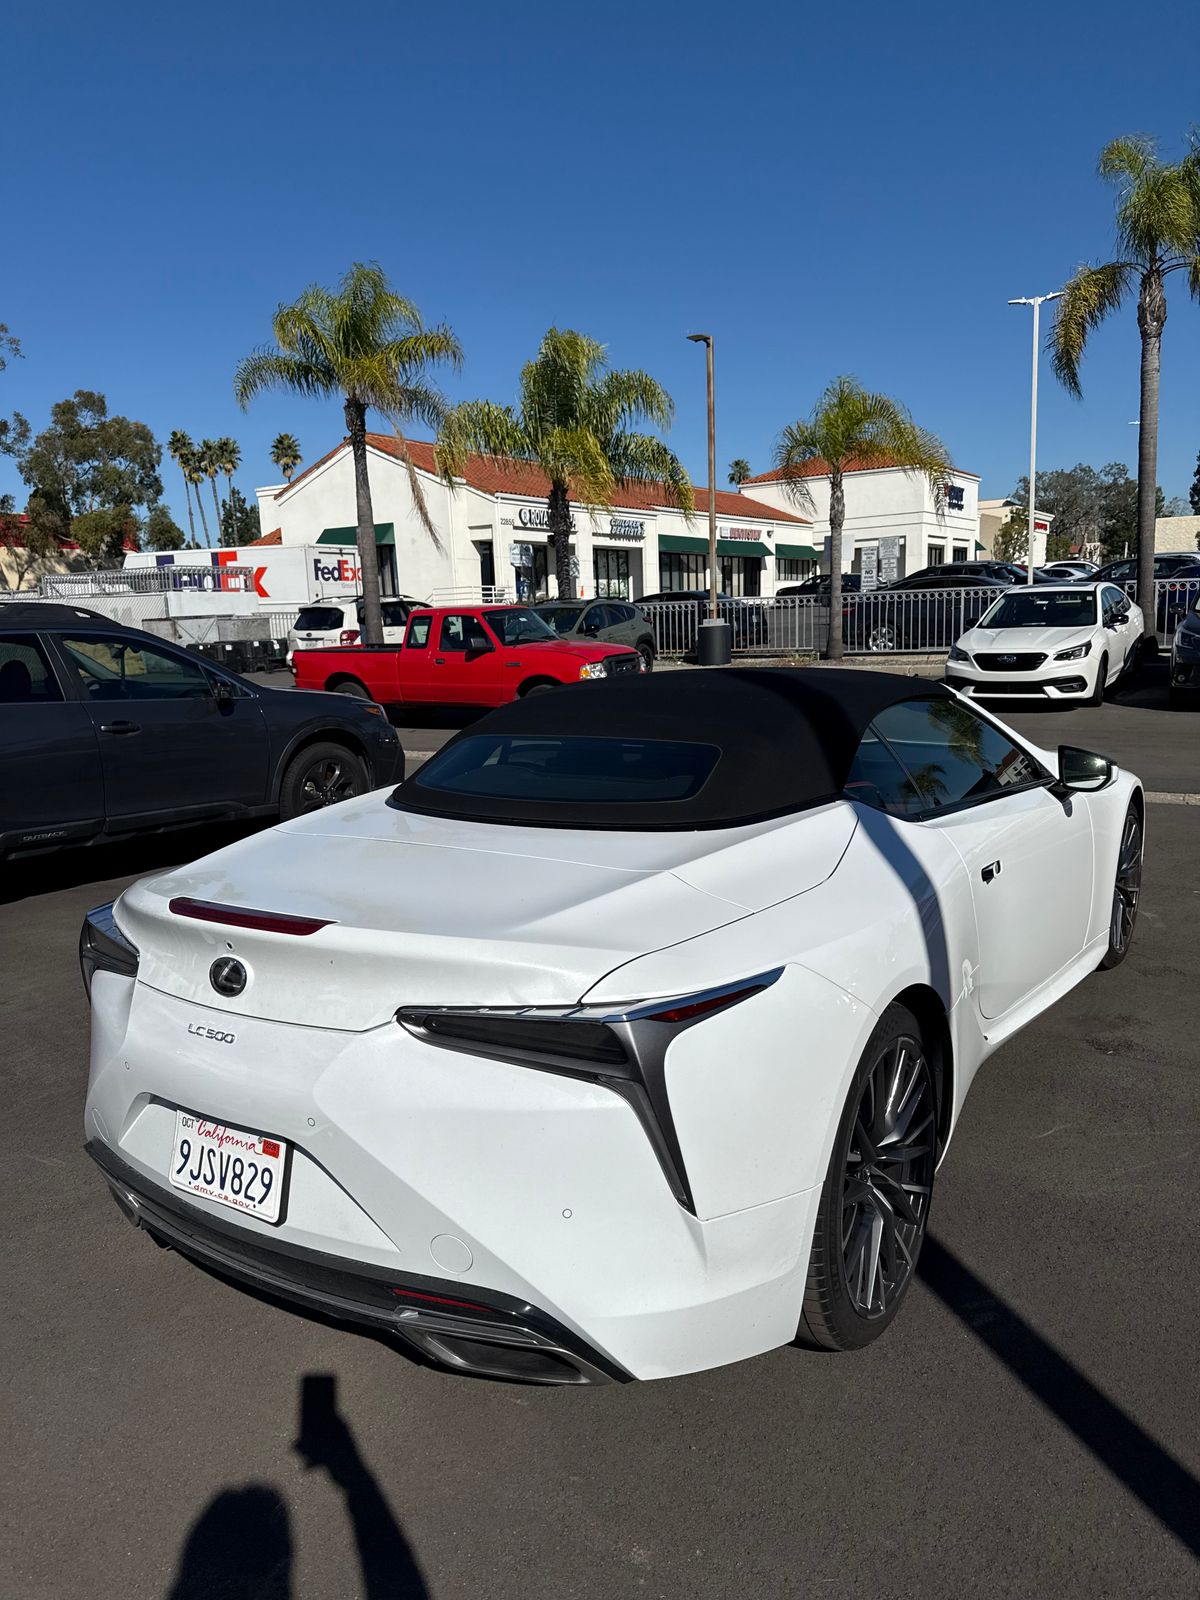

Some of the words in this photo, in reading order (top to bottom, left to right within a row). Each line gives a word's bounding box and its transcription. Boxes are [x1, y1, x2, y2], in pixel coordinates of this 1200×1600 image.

[528, 508, 552, 527] ROYA
[313, 558, 363, 582] FedEx
[182, 1116, 195, 1129] OCT
[197, 1119, 263, 1156] California
[176, 1139, 273, 1205] 9JSV829
[193, 1184, 251, 1208] dmv.ca.gov
